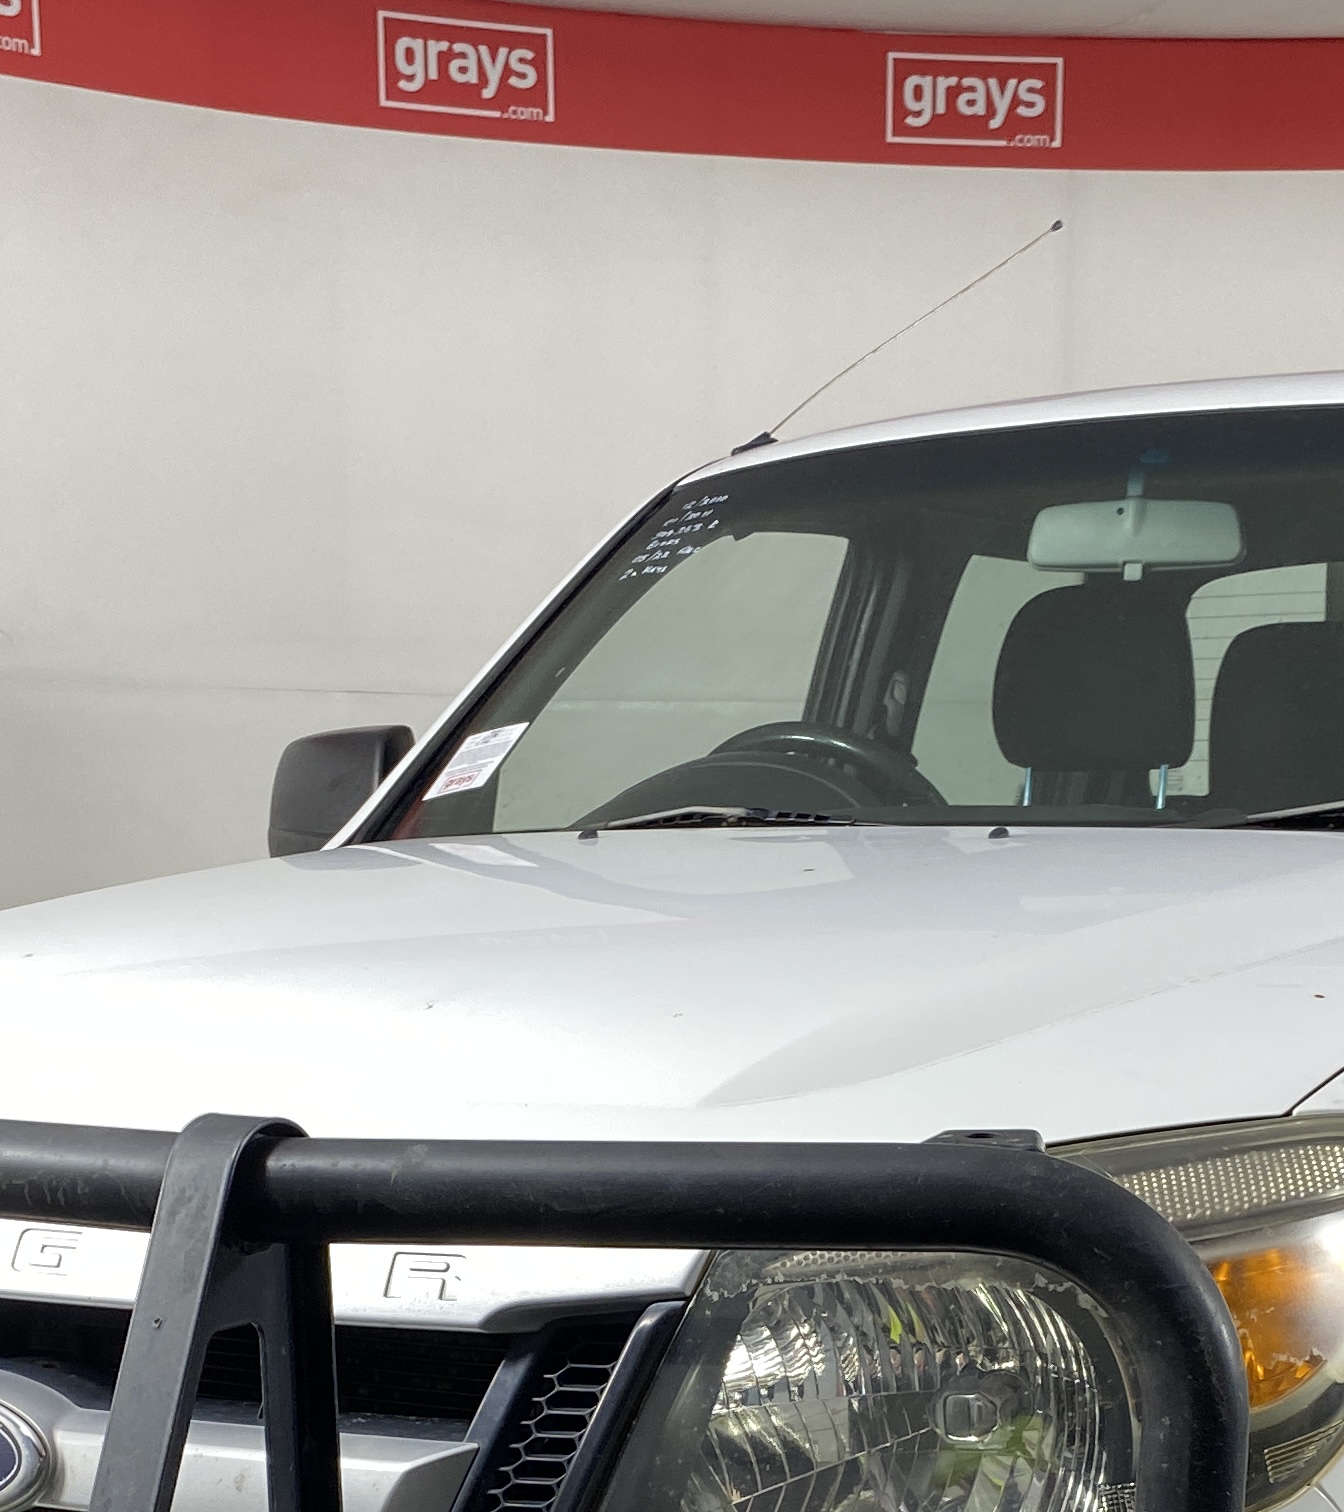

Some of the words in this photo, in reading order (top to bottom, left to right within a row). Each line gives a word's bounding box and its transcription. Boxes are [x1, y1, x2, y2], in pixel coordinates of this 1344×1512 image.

[394, 36, 538, 99] grays
[502, 105, 544, 120] .com
[903, 75, 1046, 130] grays
